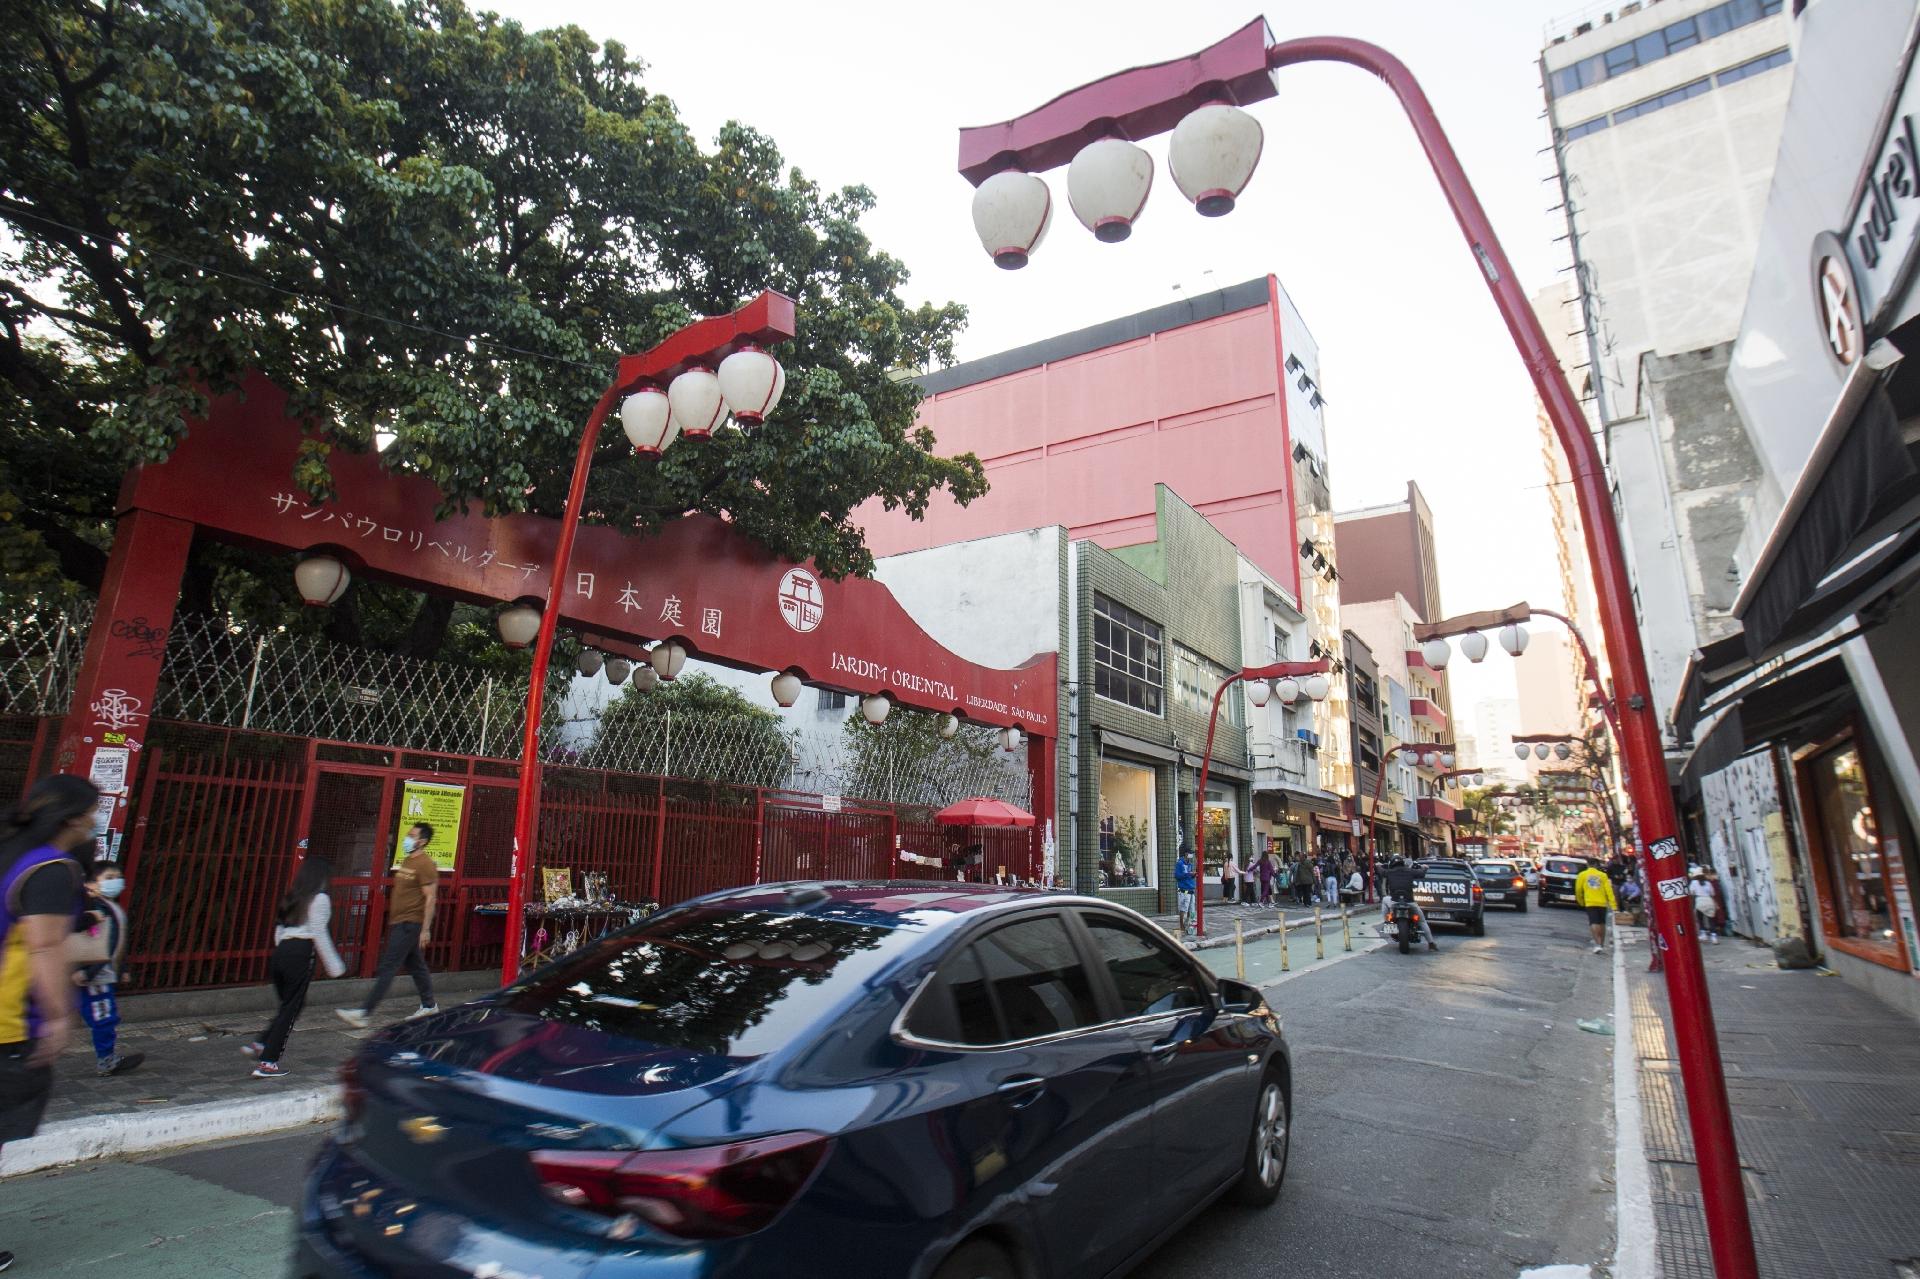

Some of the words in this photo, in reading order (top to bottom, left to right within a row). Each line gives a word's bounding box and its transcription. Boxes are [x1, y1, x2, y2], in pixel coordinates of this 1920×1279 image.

[576, 572, 722, 638] 日本庭園
[831, 652, 887, 682] JARDIM
[892, 669, 959, 701] ORIENTAL
[966, 694, 1008, 714] LIBERDADE
[1026, 711, 1048, 724] PAULO
